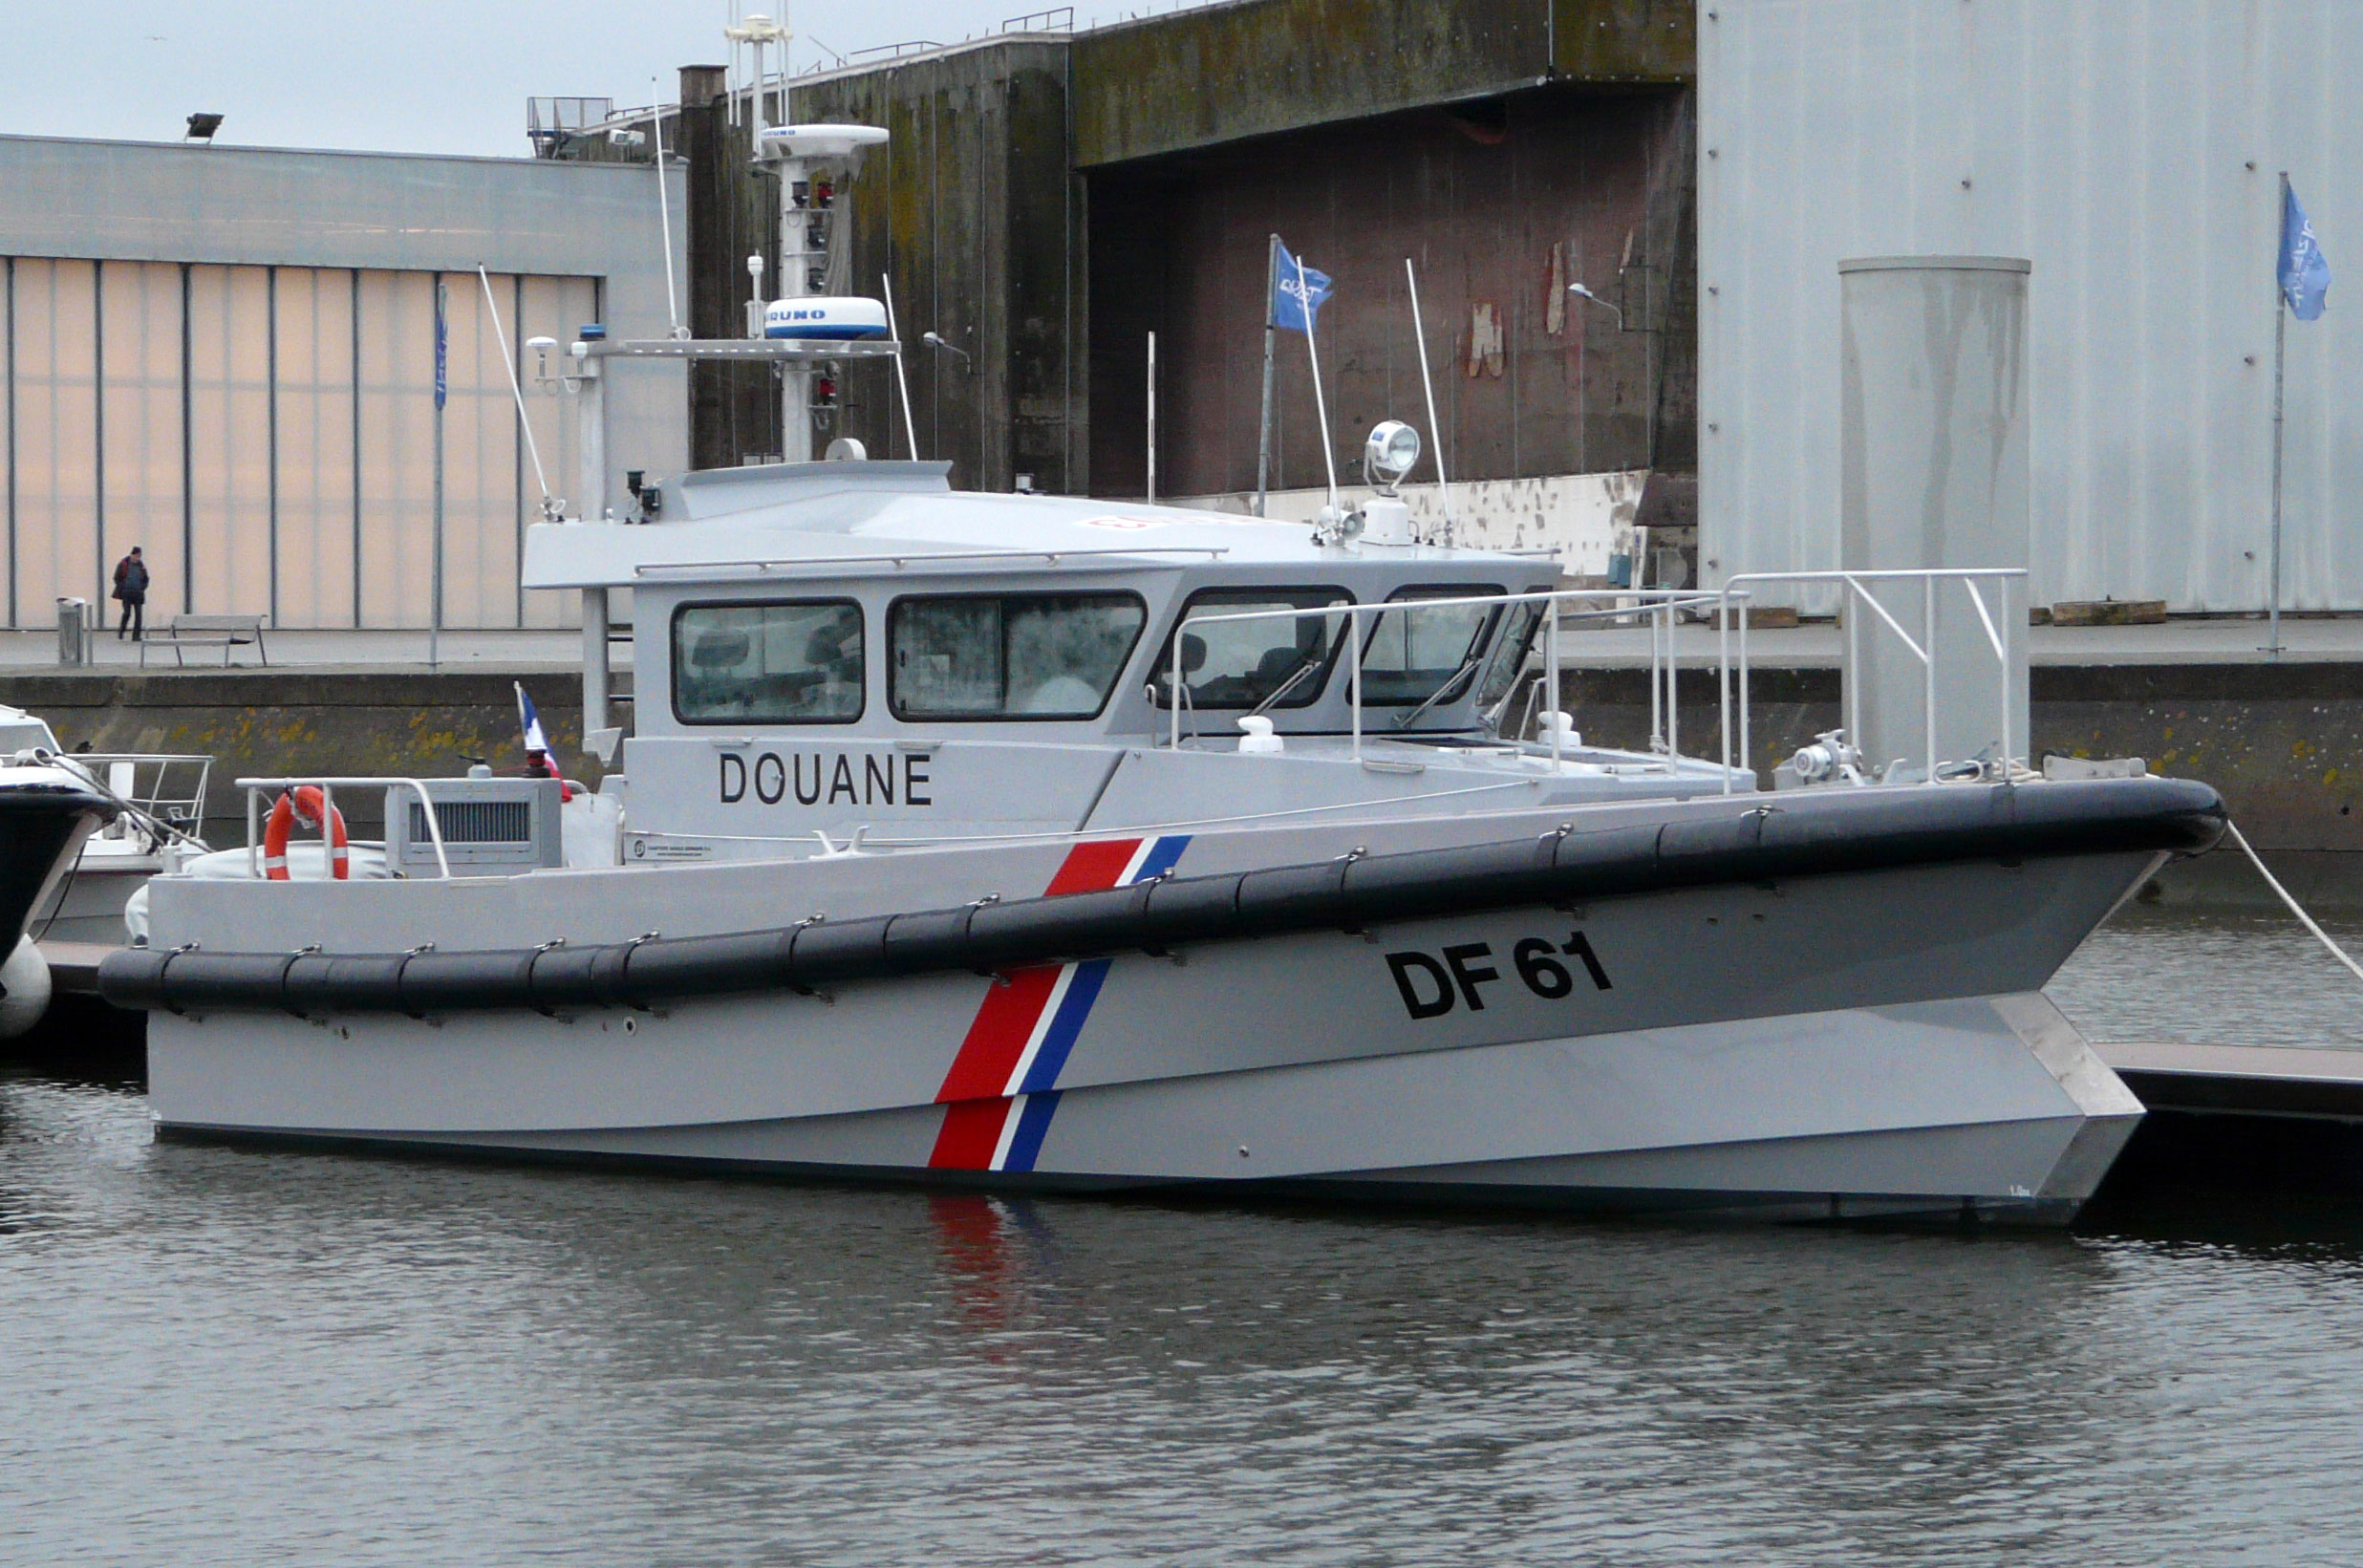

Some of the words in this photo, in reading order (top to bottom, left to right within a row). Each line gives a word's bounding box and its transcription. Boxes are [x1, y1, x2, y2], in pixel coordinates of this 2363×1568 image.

[720, 752, 933, 806] DOUANE
[1384, 941, 1501, 1020] DF
[1512, 930, 1614, 1000] 61
